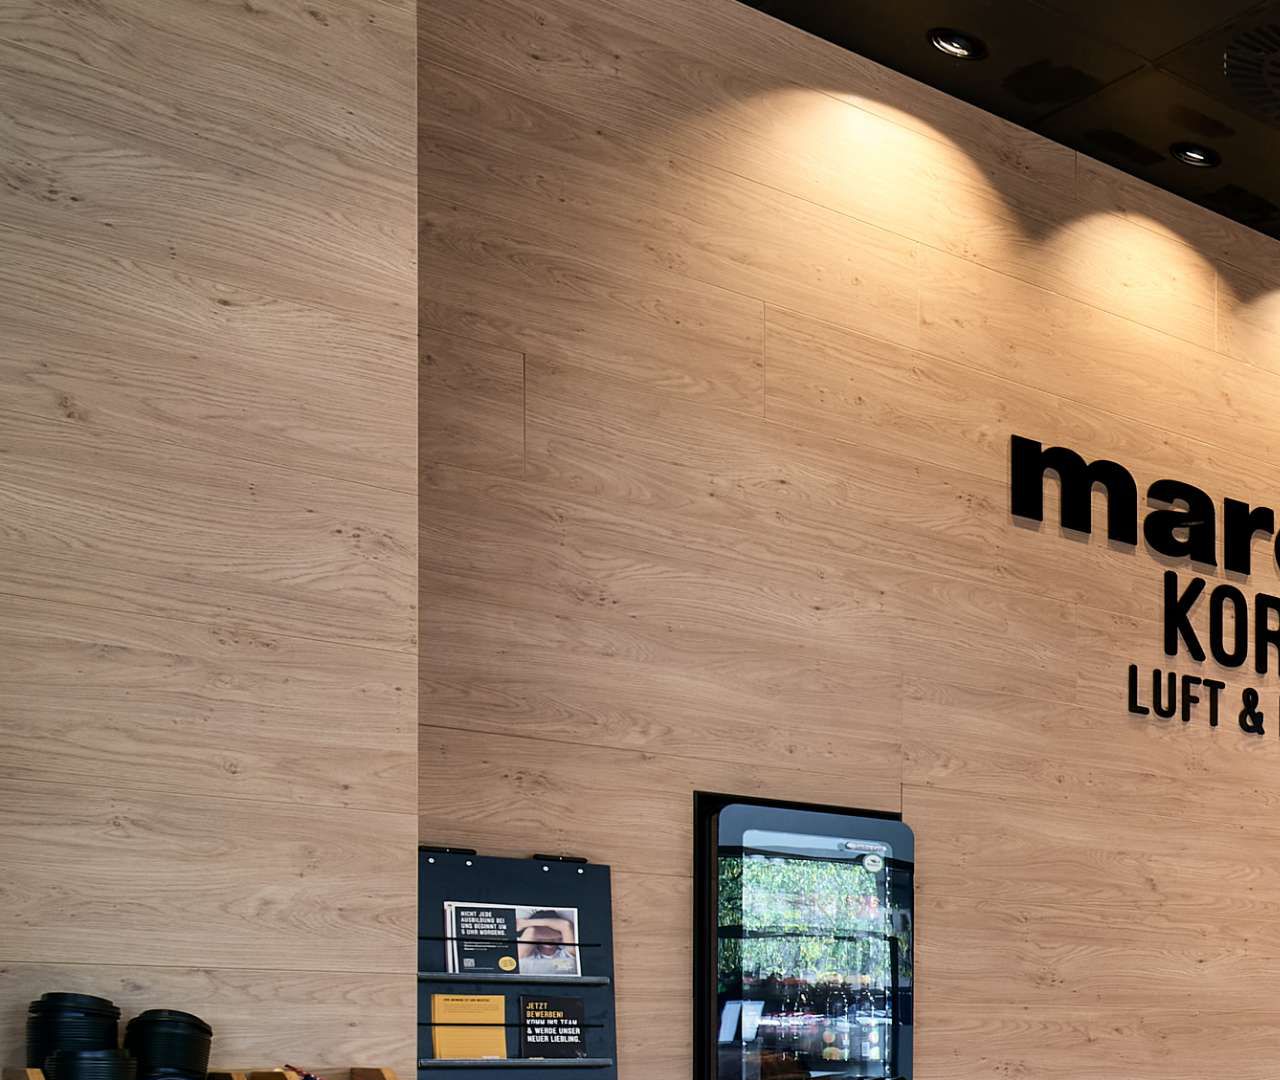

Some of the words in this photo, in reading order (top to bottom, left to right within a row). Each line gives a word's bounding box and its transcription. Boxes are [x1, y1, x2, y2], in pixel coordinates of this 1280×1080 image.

[1128, 664, 1225, 727] LUFT
[1238, 688, 1264, 735] &
[526, 1002, 548, 1010] JETZT
[527, 1035, 549, 1043] NEUER
